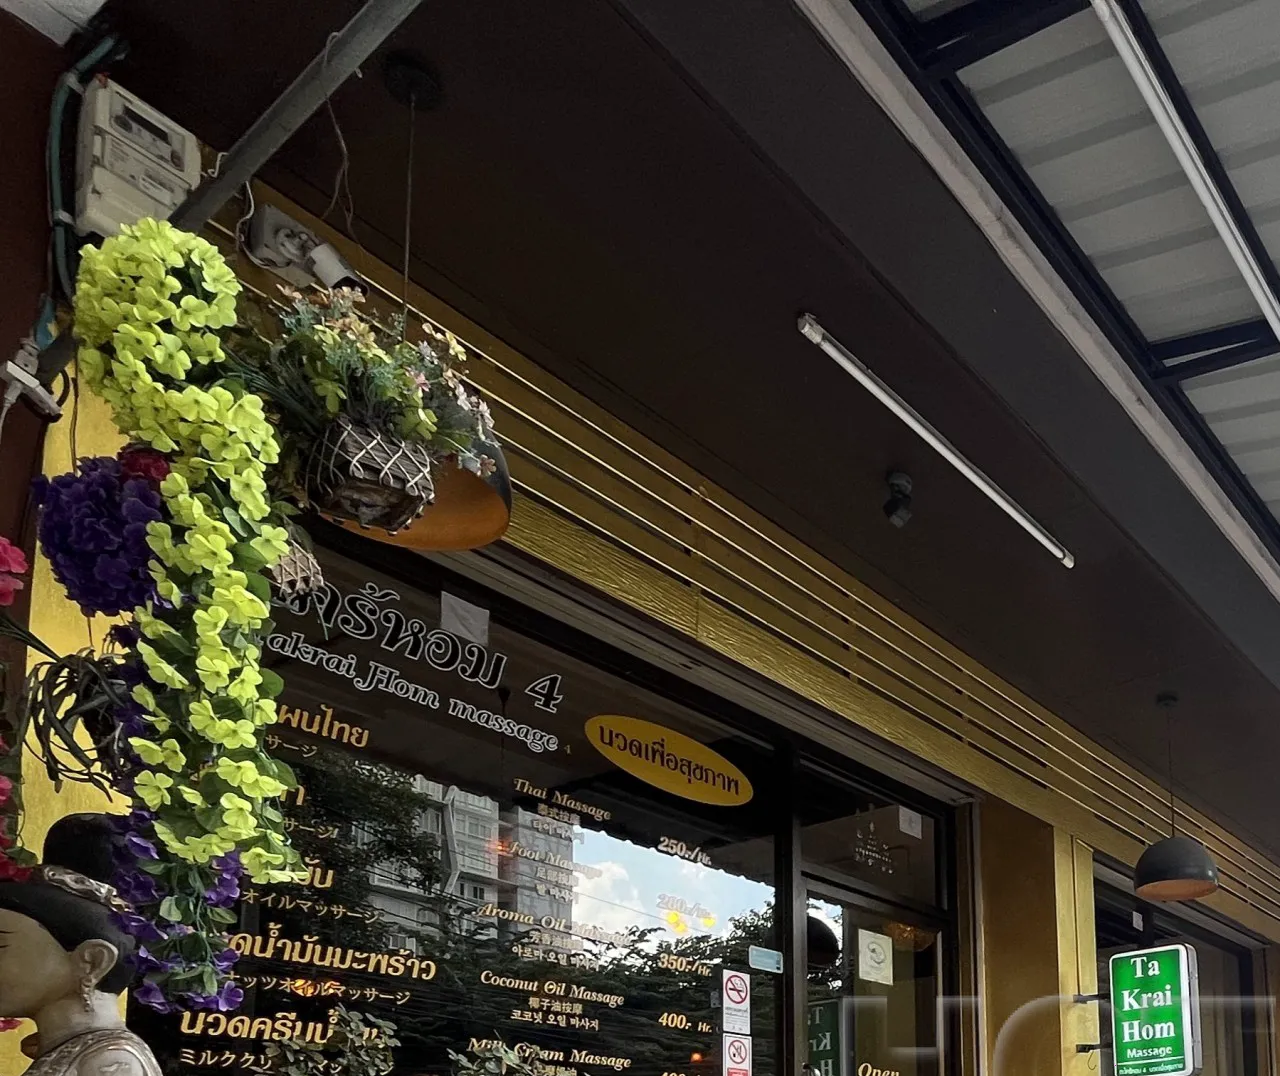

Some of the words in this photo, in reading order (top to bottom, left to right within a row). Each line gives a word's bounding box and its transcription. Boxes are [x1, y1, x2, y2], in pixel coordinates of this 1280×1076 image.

[258, 632, 357, 678] akrai
[449, 697, 559, 752] massage
[525, 673, 564, 714] 4
[598, 725, 740, 796] นวดเพื่อสุขภาพ
[513, 777, 547, 800] Thai
[552, 790, 612, 821] Massage
[474, 903, 535, 925] Aroma
[540, 915, 567, 931] Oil
[1130, 956, 1161, 979] Ta
[480, 970, 540, 992] Coconut
[544, 980, 567, 996] Oil
[570, 984, 625, 1009] Massage
[1121, 984, 1173, 1012] Krai
[569, 1016, 600, 1032] 마사지
[1121, 1021, 1176, 1043] Hom
[569, 1048, 632, 1072] Massage
[1127, 1046, 1173, 1059] Massage
